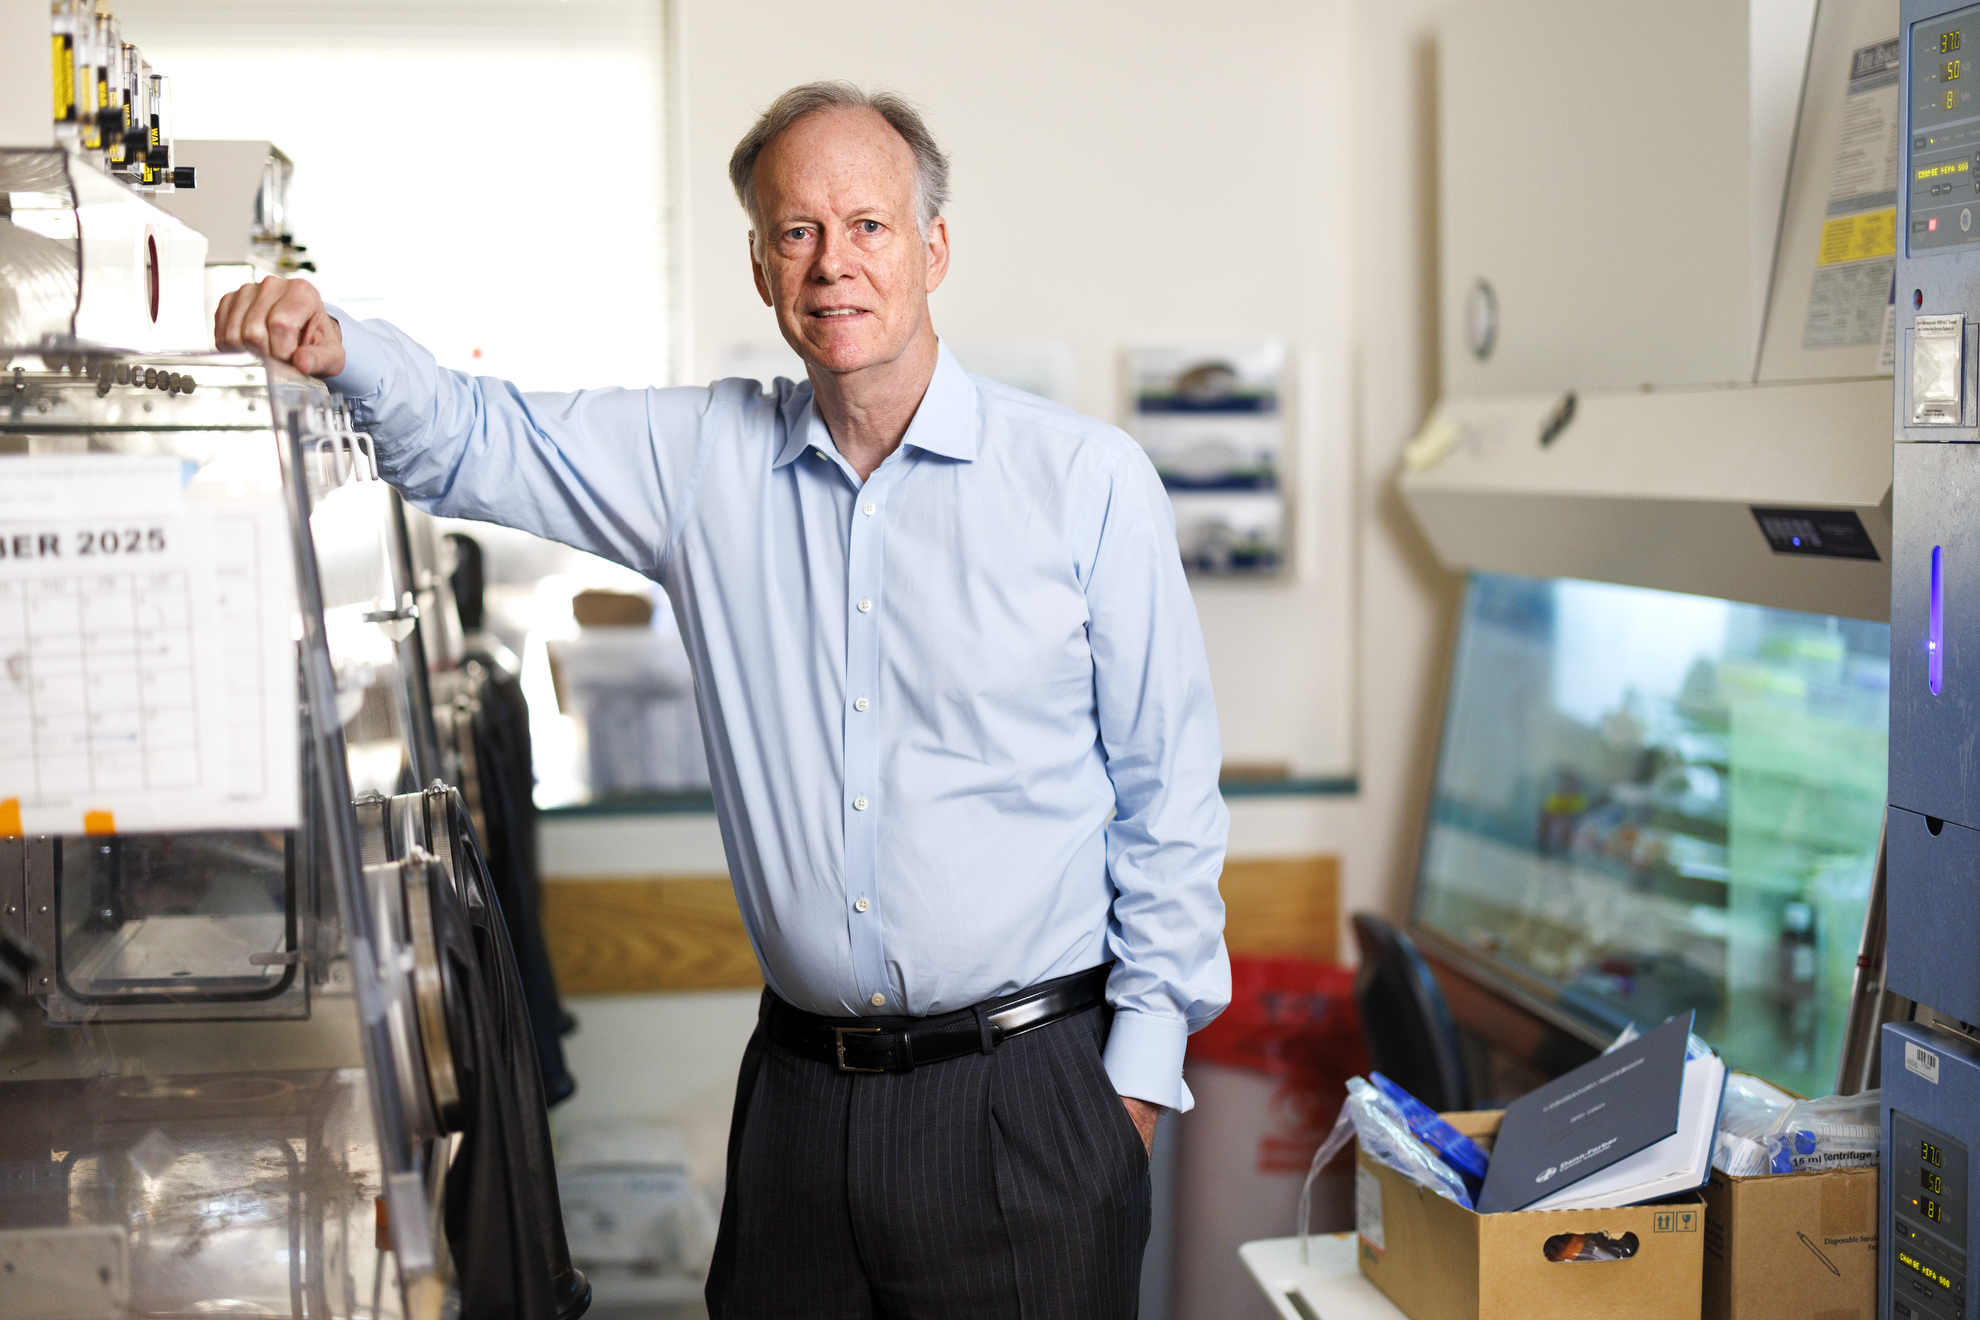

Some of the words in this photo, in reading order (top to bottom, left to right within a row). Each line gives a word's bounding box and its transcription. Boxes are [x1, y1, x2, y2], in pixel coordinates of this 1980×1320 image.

[77, 527, 166, 556] 2025
[1560, 1137, 1618, 1169] Dana-Farber
[1793, 1157, 1804, 1167] 15
[1928, 1201, 1941, 1223] 81
[1824, 1236, 1859, 1246] Disposable
